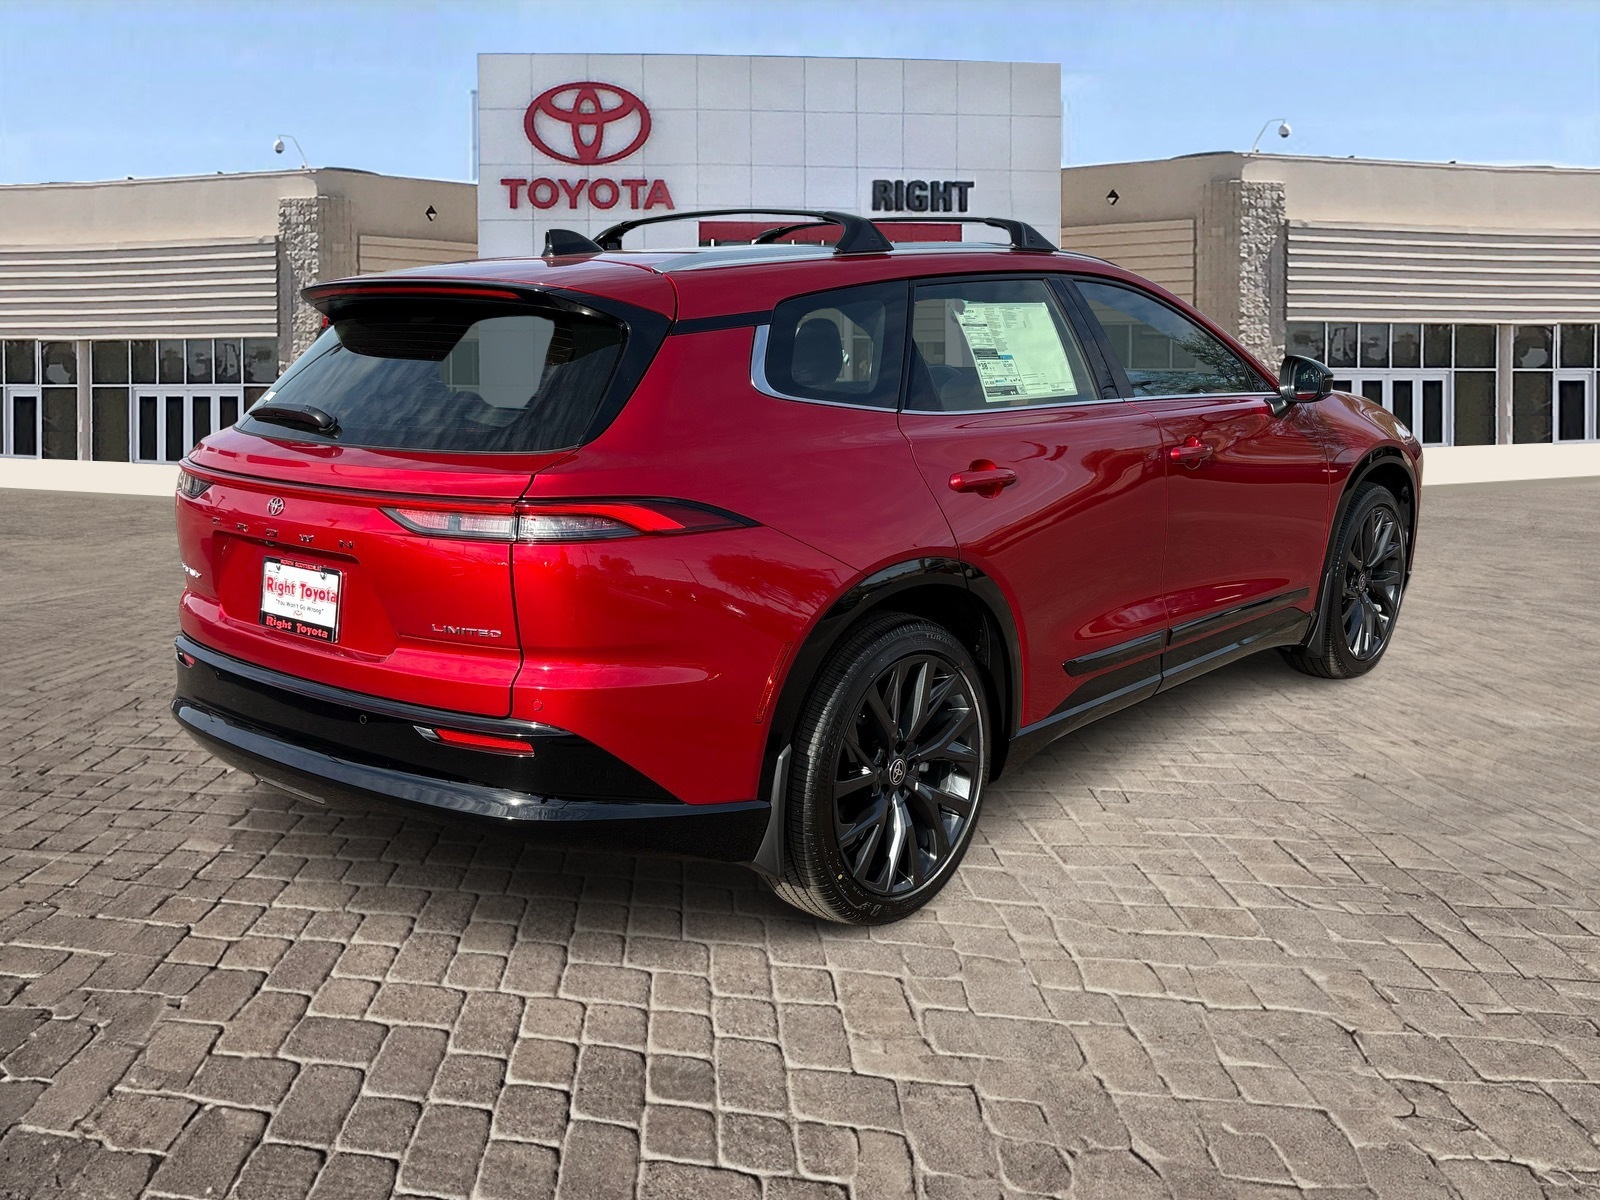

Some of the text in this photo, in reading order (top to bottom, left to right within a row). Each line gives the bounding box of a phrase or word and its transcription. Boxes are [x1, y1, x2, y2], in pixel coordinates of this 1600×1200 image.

[500, 178, 675, 210] TOYOTA
[871, 179, 976, 213] RIGHT
[211, 516, 355, 549] CROWN
[266, 576, 337, 605] Right Toyota
[265, 616, 329, 639] Right Toyota
[431, 623, 503, 639] LIMITED
